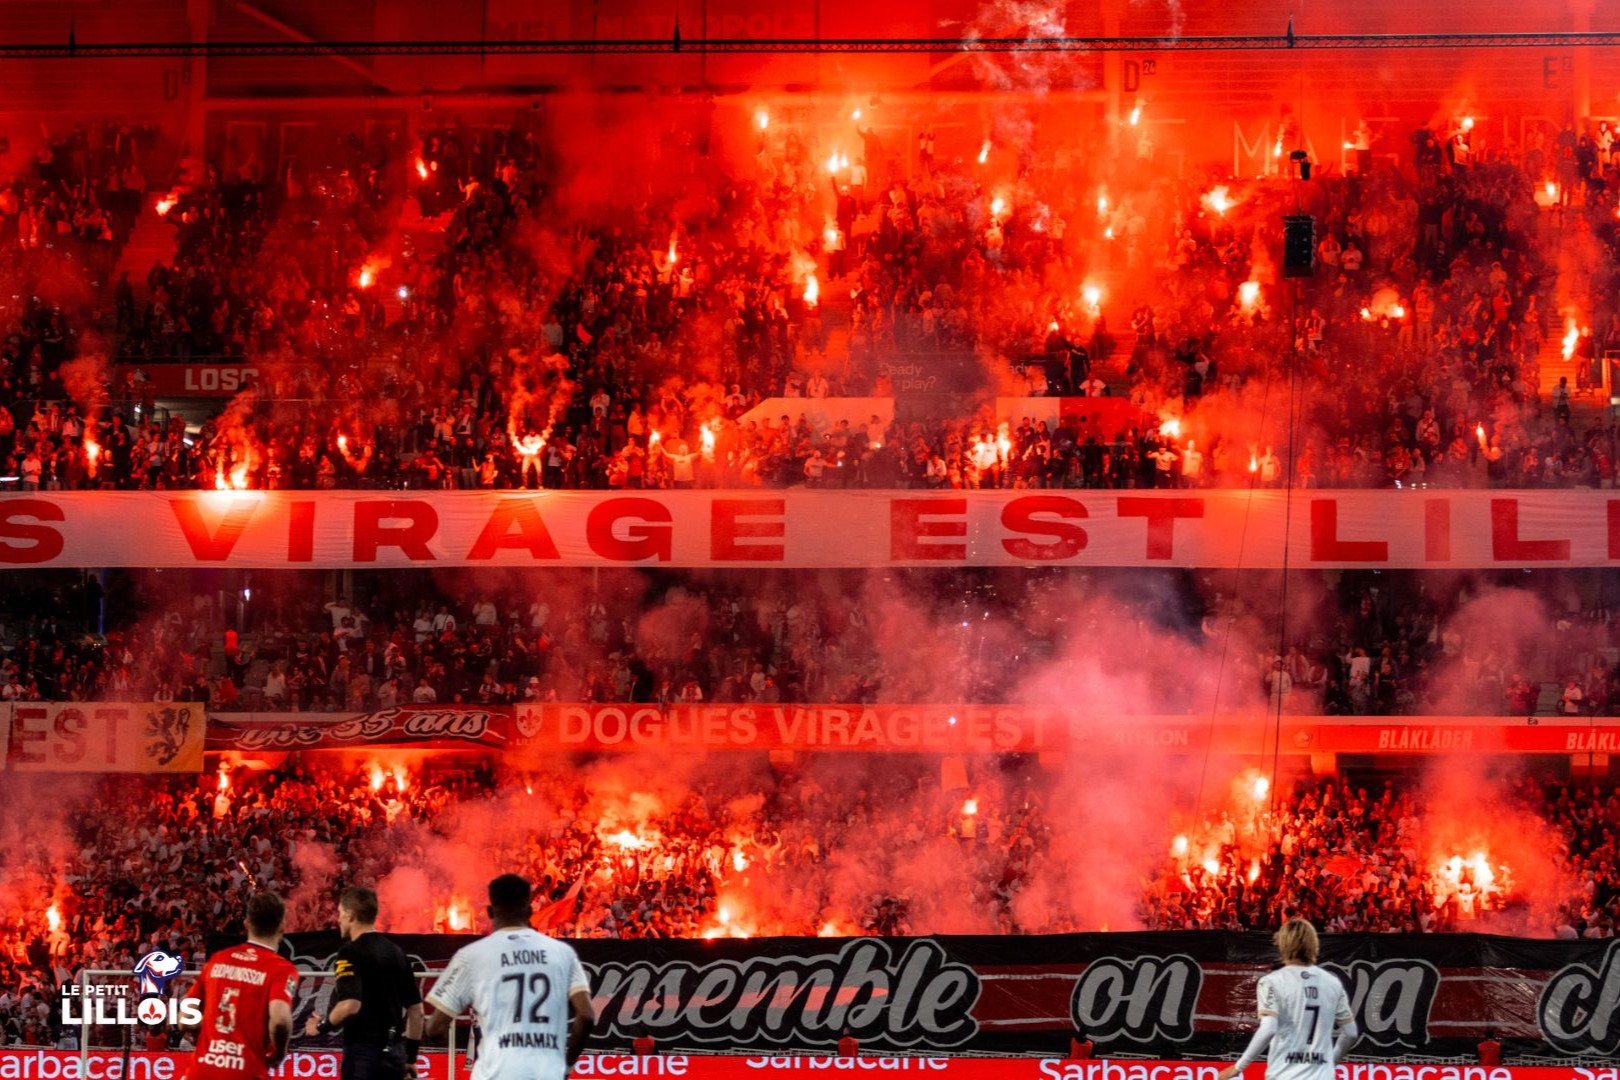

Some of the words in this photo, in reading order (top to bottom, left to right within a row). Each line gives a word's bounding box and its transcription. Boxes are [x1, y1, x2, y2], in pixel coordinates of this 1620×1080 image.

[989, 361, 1032, 377] Rady
[902, 375, 937, 392] play?
[168, 498, 785, 563] VIRAGE
[890, 496, 1204, 561] EST
[1310, 498, 1620, 562] LIL
[12, 707, 129, 764] EST
[404, 710, 490, 738] ans
[559, 706, 757, 745] DOGUES
[772, 707, 948, 746] VIRAGE
[967, 709, 1048, 747] EST
[1566, 729, 1620, 750] BLÅKL
[501, 950, 548, 967] A.KONE
[214, 986, 240, 1035] 5
[501, 972, 551, 1024] 72
[1073, 957, 1200, 1038] on
[1304, 1005, 1321, 1045] 7
[208, 1039, 245, 1056] user
[0, 1051, 175, 1080] arbacane
[198, 1053, 245, 1071] .com
[574, 1055, 689, 1075] acane
[1333, 1063, 1512, 1080] arbacane
